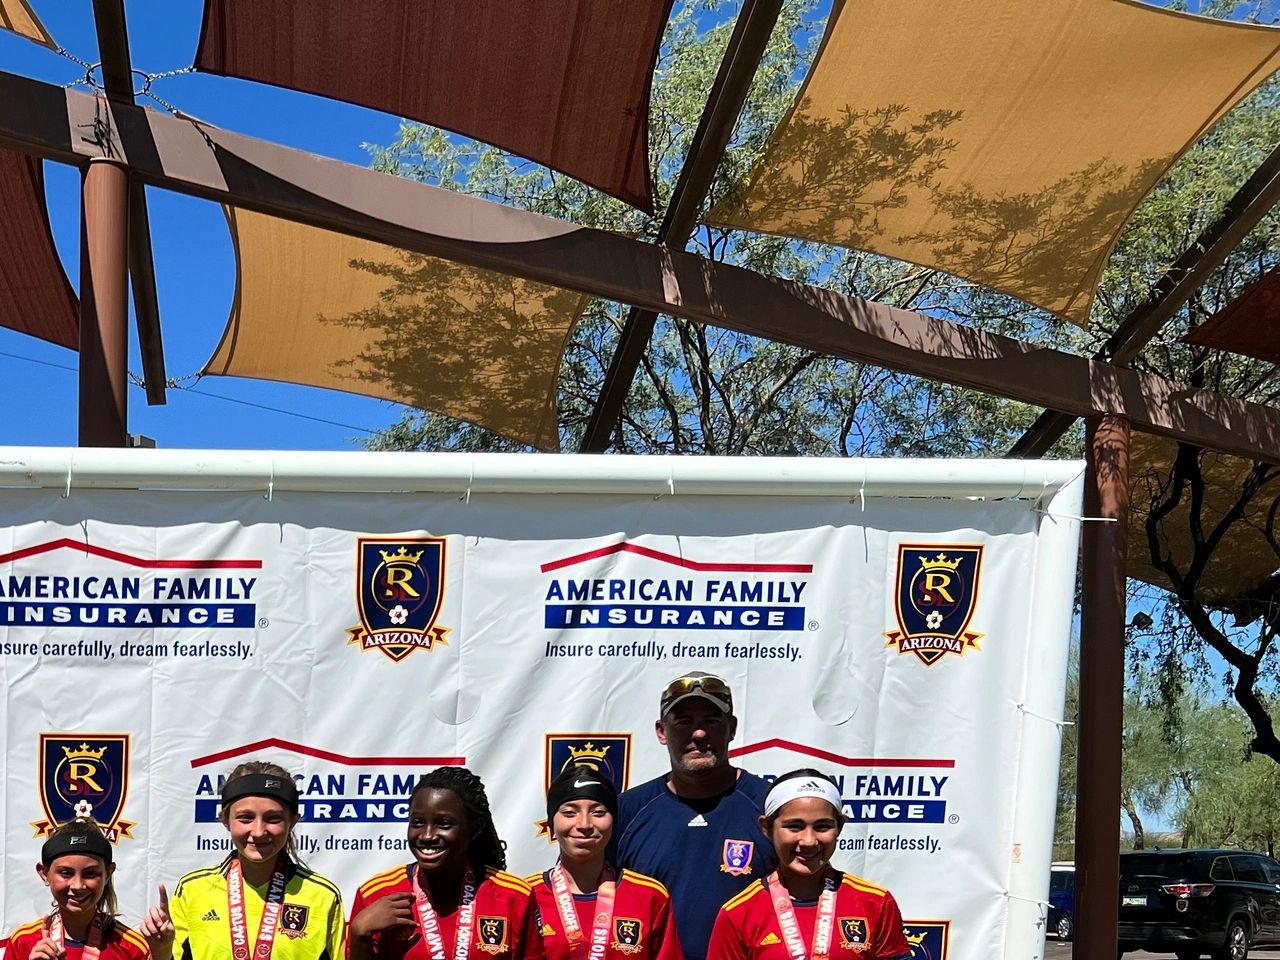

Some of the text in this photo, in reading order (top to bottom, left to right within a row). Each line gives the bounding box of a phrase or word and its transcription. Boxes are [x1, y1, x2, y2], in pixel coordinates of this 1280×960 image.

[153, 577, 256, 600] FAMILY
[546, 578, 807, 603] AMERICAN FAMILY
[7, 605, 235, 624] INSURANCE
[565, 608, 785, 627] INSURANCE
[42, 638, 116, 659] carefully,
[120, 640, 169, 657] dream
[172, 640, 253, 660] fearlessly.
[364, 631, 431, 648] ARIZONA
[901, 636, 963, 653] ARIZONA
[546, 641, 803, 662] Insure carefully, dream fearlessly.
[358, 774, 416, 795] FAM
[856, 775, 948, 797] FAMILY
[197, 835, 234, 850] Insu
[325, 835, 373, 851] dream
[836, 835, 942, 853] ream fearlessly.
[260, 872, 284, 941] CHAMPIONS
[231, 906, 245, 946] CACTUS
